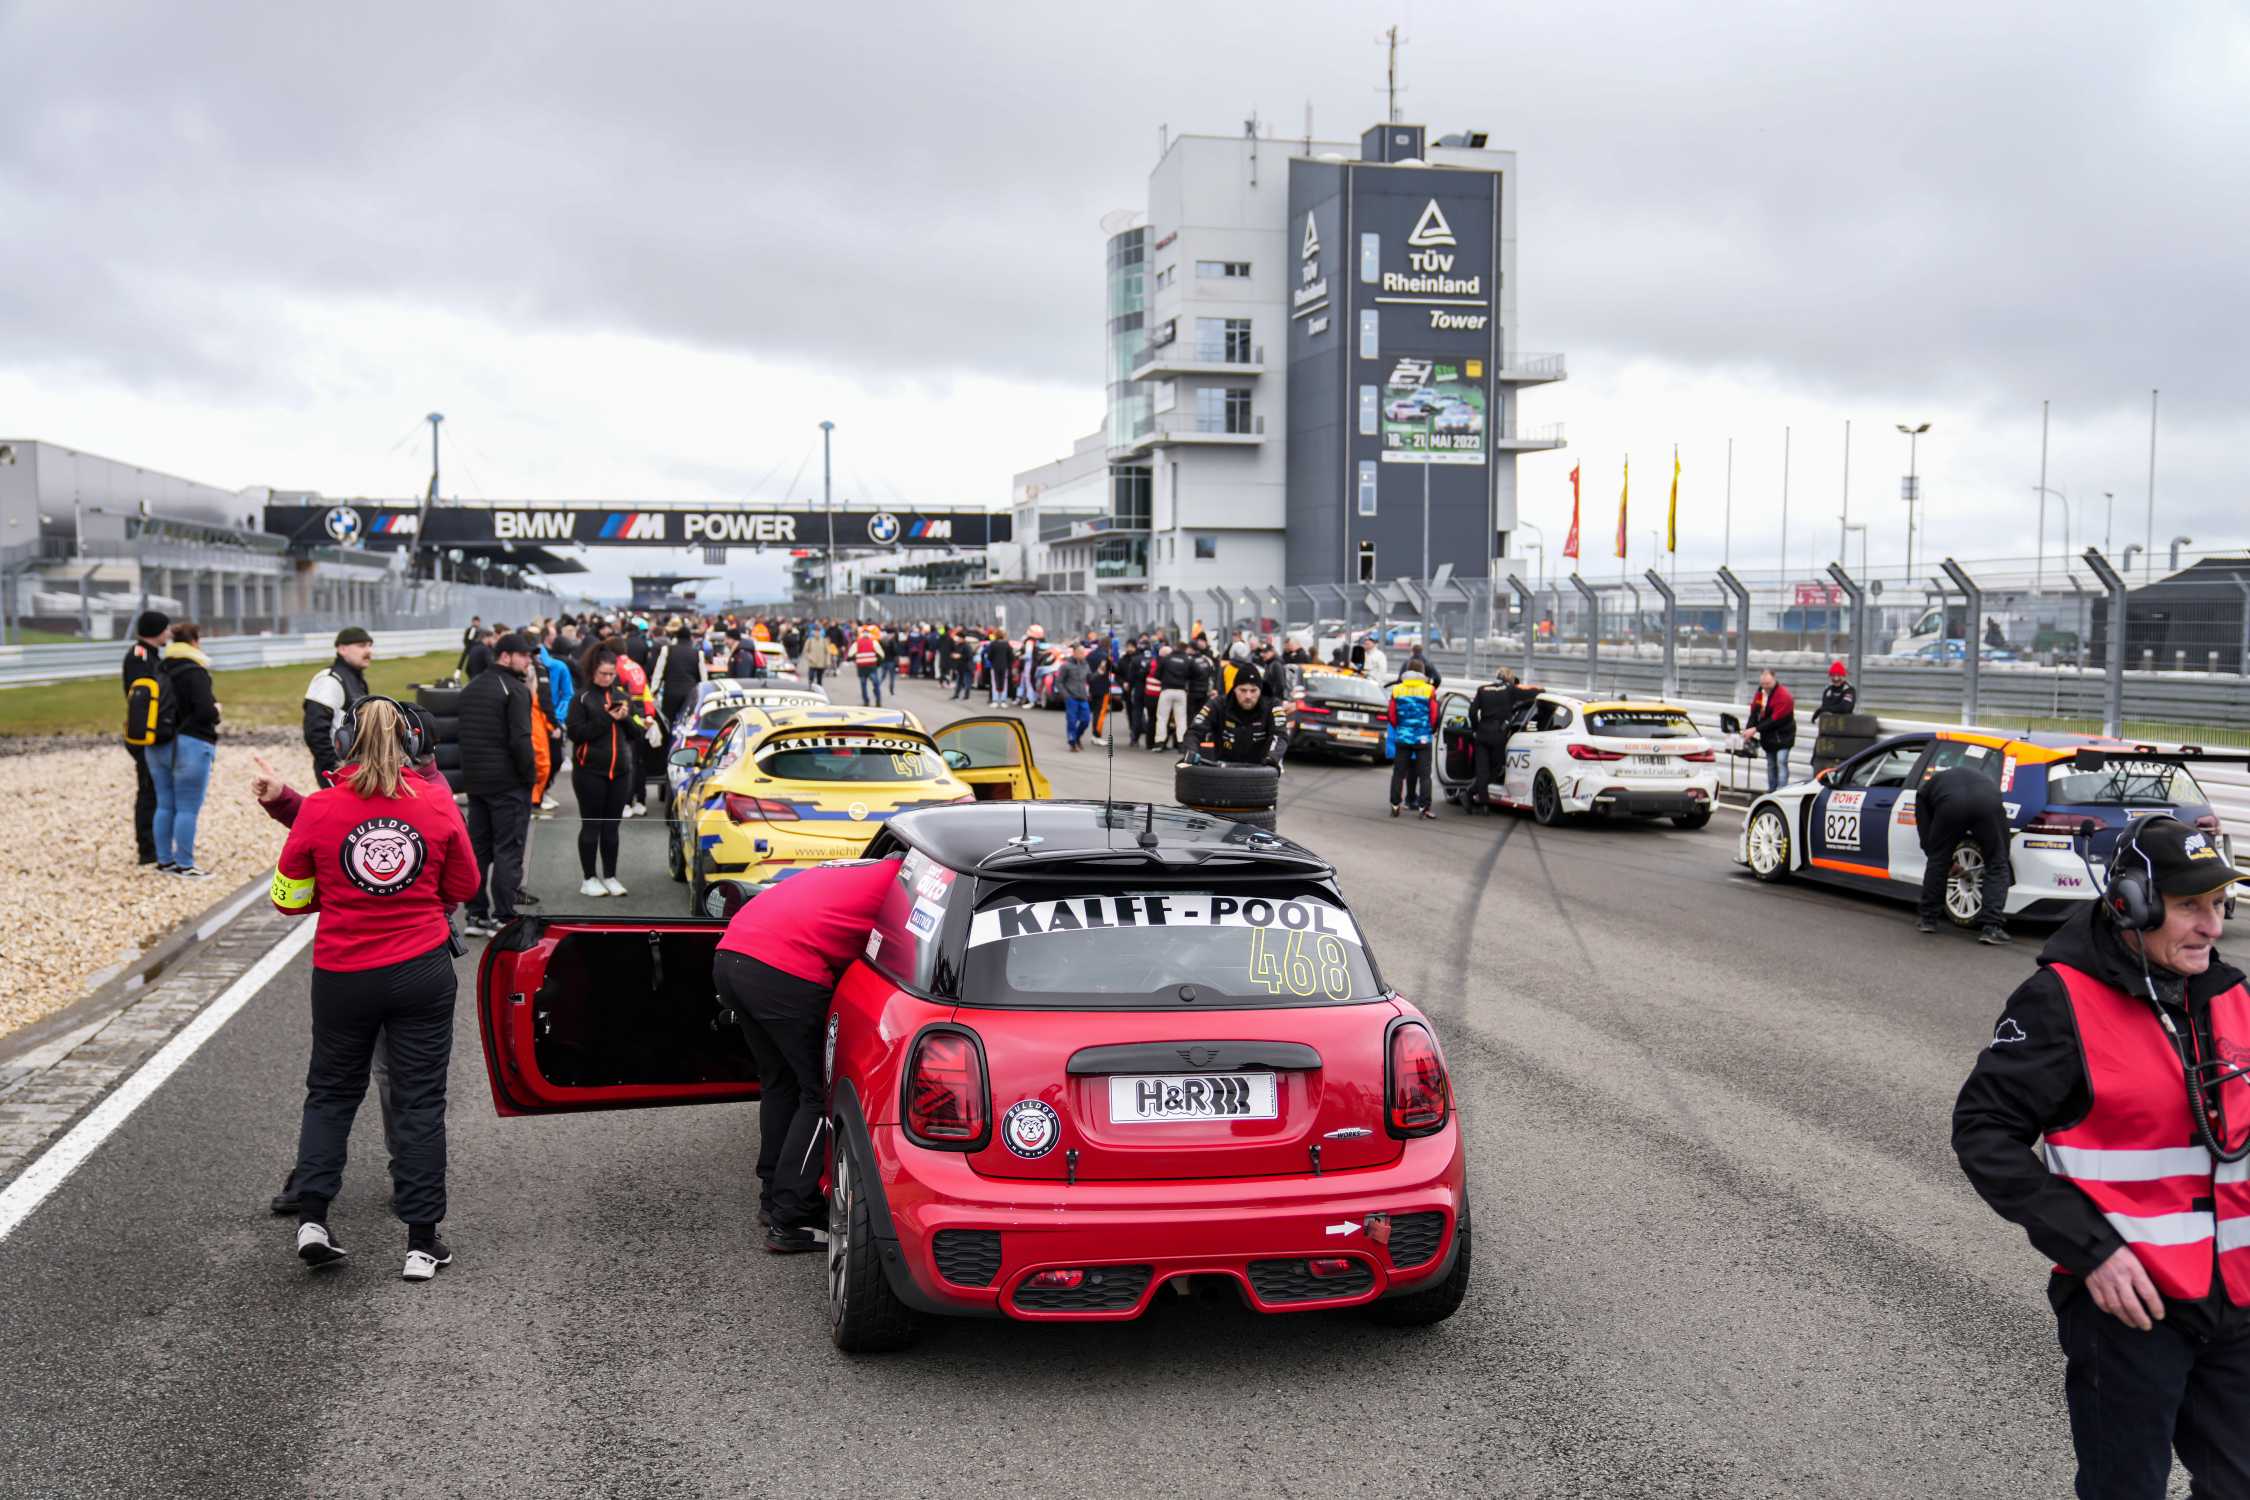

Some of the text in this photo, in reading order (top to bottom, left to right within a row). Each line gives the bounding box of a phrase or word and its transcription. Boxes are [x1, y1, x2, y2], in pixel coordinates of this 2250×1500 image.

[1409, 250, 1455, 272] TÜV
[1383, 272, 1480, 295] Rheinland
[1429, 310, 1488, 330] Tower
[1431, 434, 1452, 448] MAI
[1452, 434, 1481, 448] 2023
[494, 511, 575, 539] BMW
[684, 513, 796, 541] POWER
[1832, 792, 1862, 804] ROWE
[347, 819, 420, 844] BULLDOG
[1826, 814, 1858, 841] 822
[998, 895, 1173, 938] KALFF
[1209, 896, 1338, 936] POOL
[1248, 926, 1352, 1001] 468
[1008, 1101, 1056, 1119] BULLDOG
[1135, 1078, 1213, 1118] H&R
